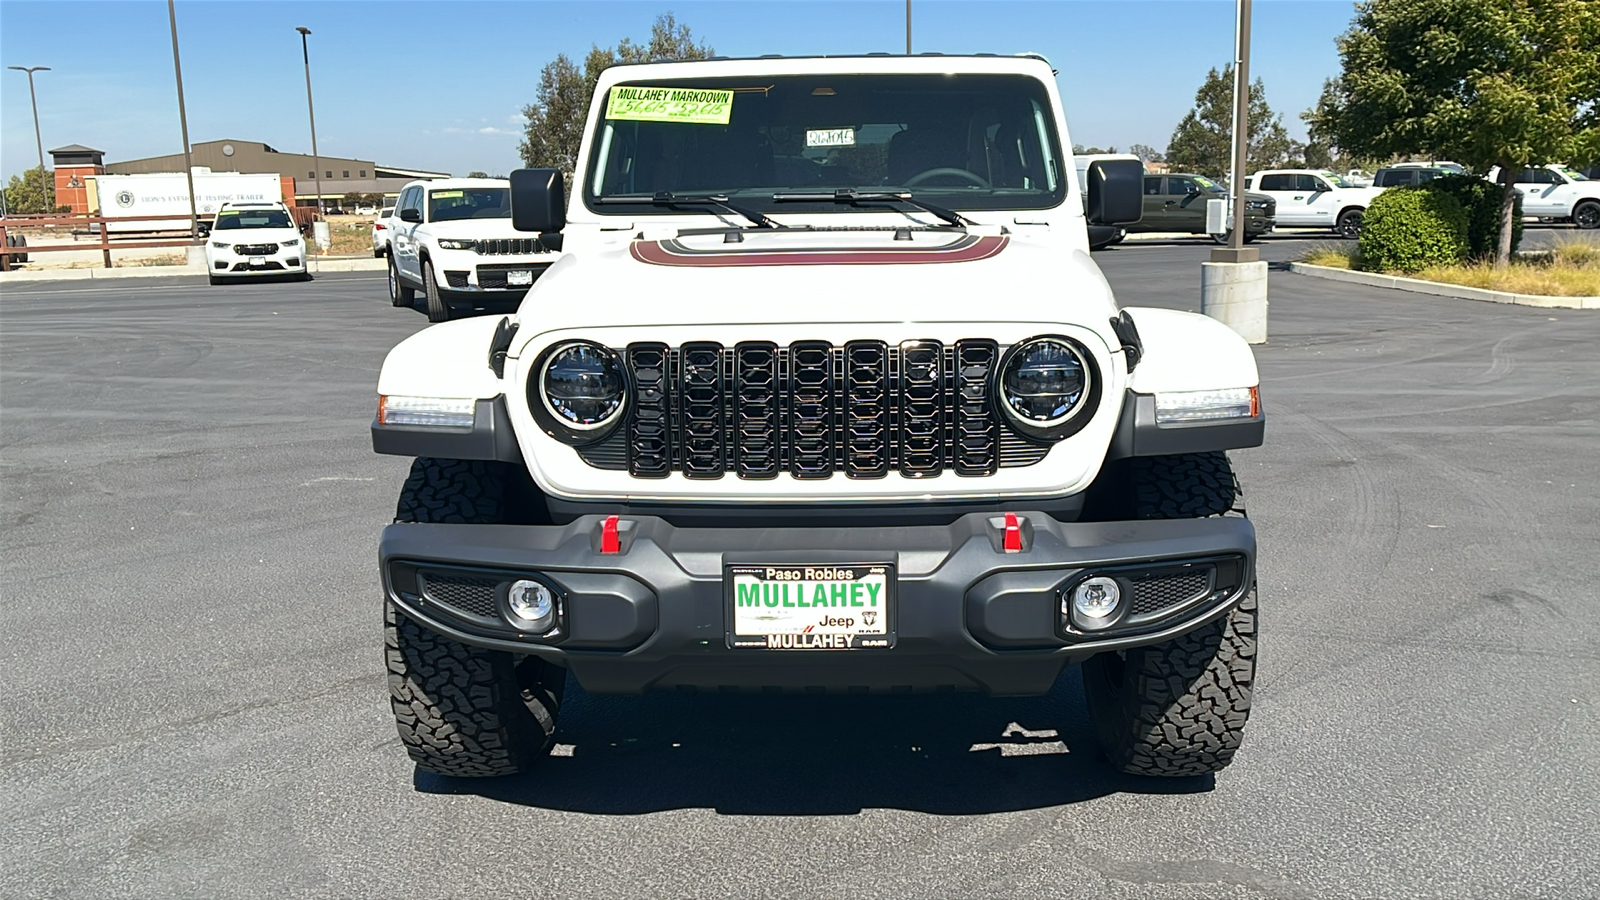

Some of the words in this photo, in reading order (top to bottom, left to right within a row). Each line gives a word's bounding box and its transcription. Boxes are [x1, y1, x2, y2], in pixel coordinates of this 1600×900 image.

[617, 88, 670, 101] MULLAHEY
[670, 90, 730, 103] MARKDOWN
[168, 194, 202, 202] EYESIT
[766, 568, 802, 580] Paso
[804, 567, 854, 580] Robles
[737, 582, 882, 608] MULLAHEY
[819, 615, 855, 628] Jeep
[767, 634, 855, 649] MULLAHEY
